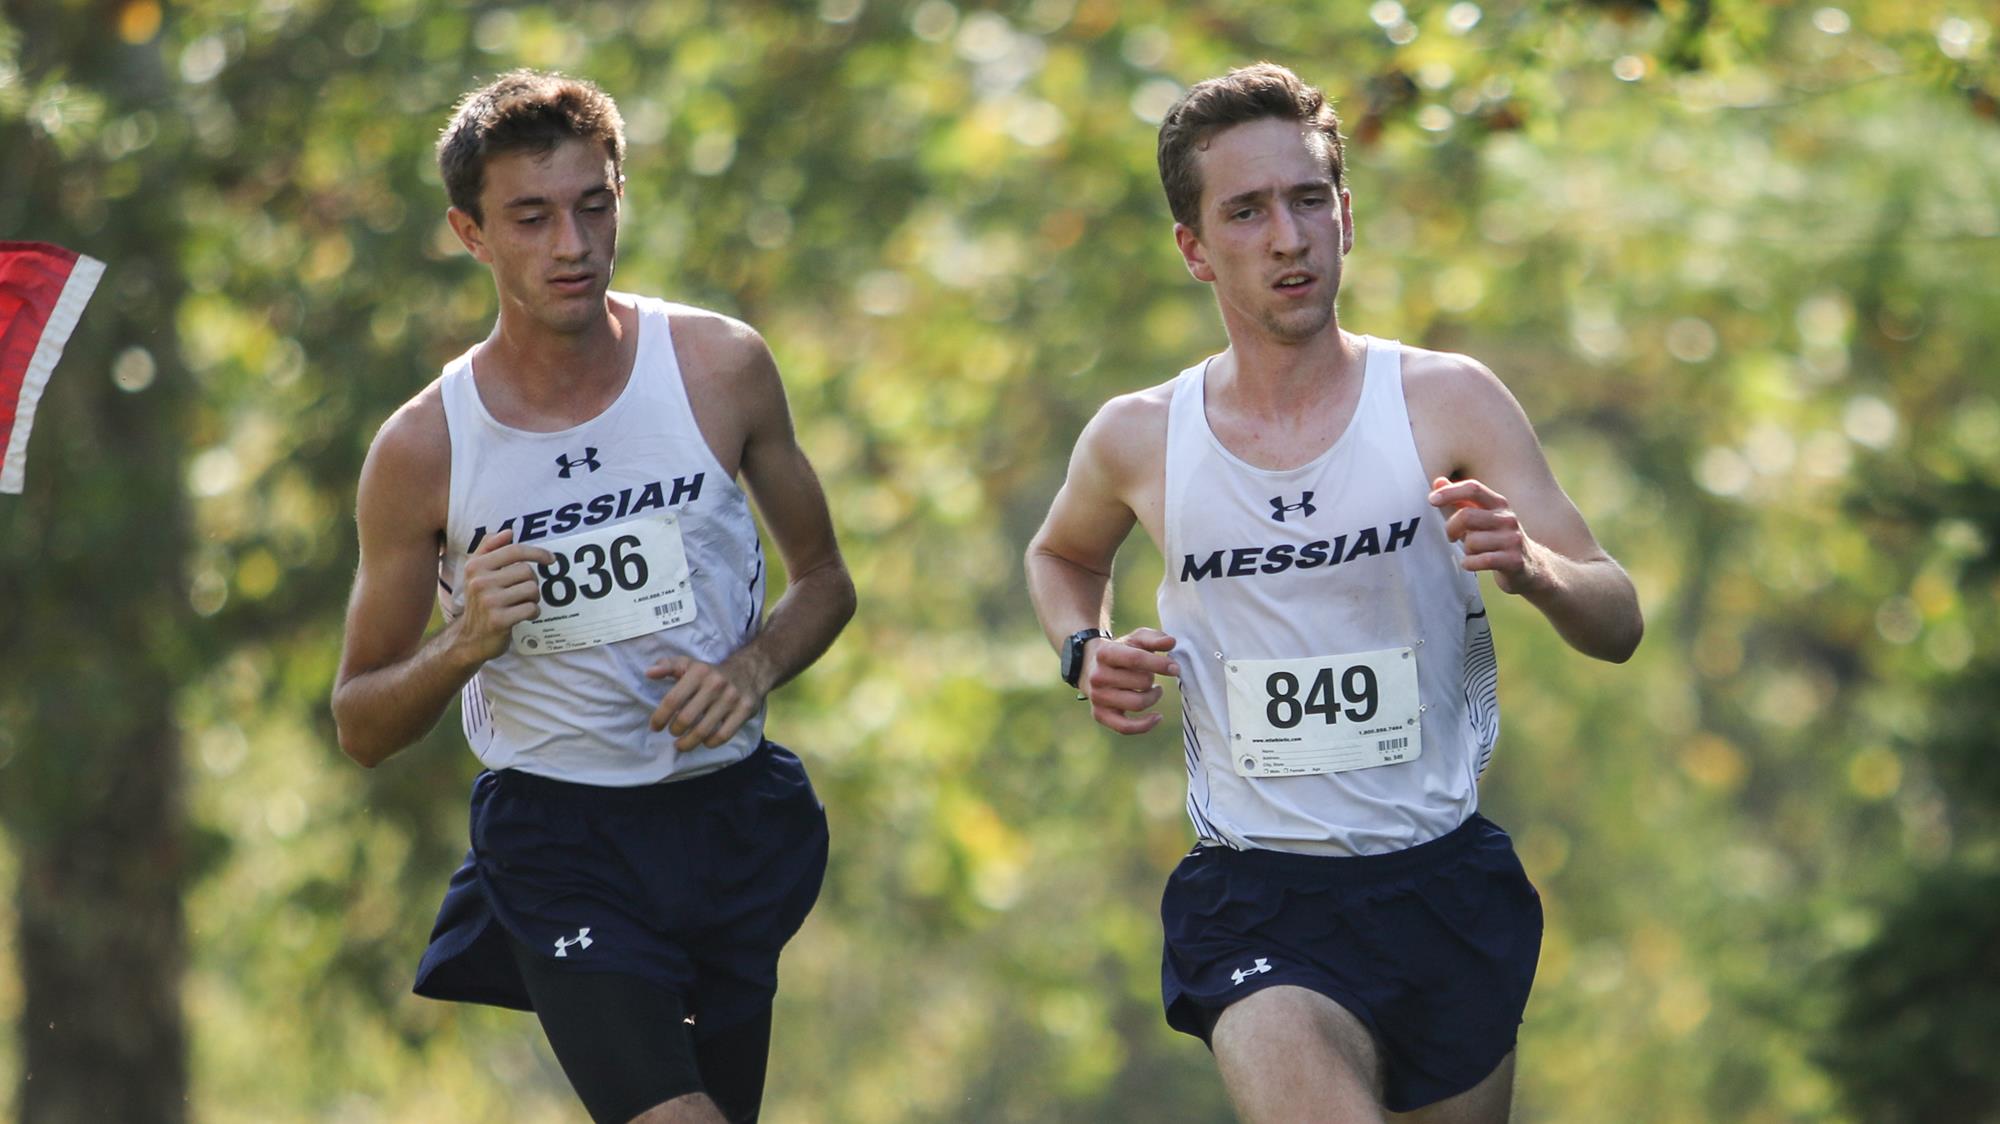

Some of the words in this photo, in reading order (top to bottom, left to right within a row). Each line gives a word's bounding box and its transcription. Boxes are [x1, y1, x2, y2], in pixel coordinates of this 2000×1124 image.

[537, 534, 649, 607] 836
[1180, 517, 1421, 582] MESSIAH
[1265, 665, 1379, 729] 849
